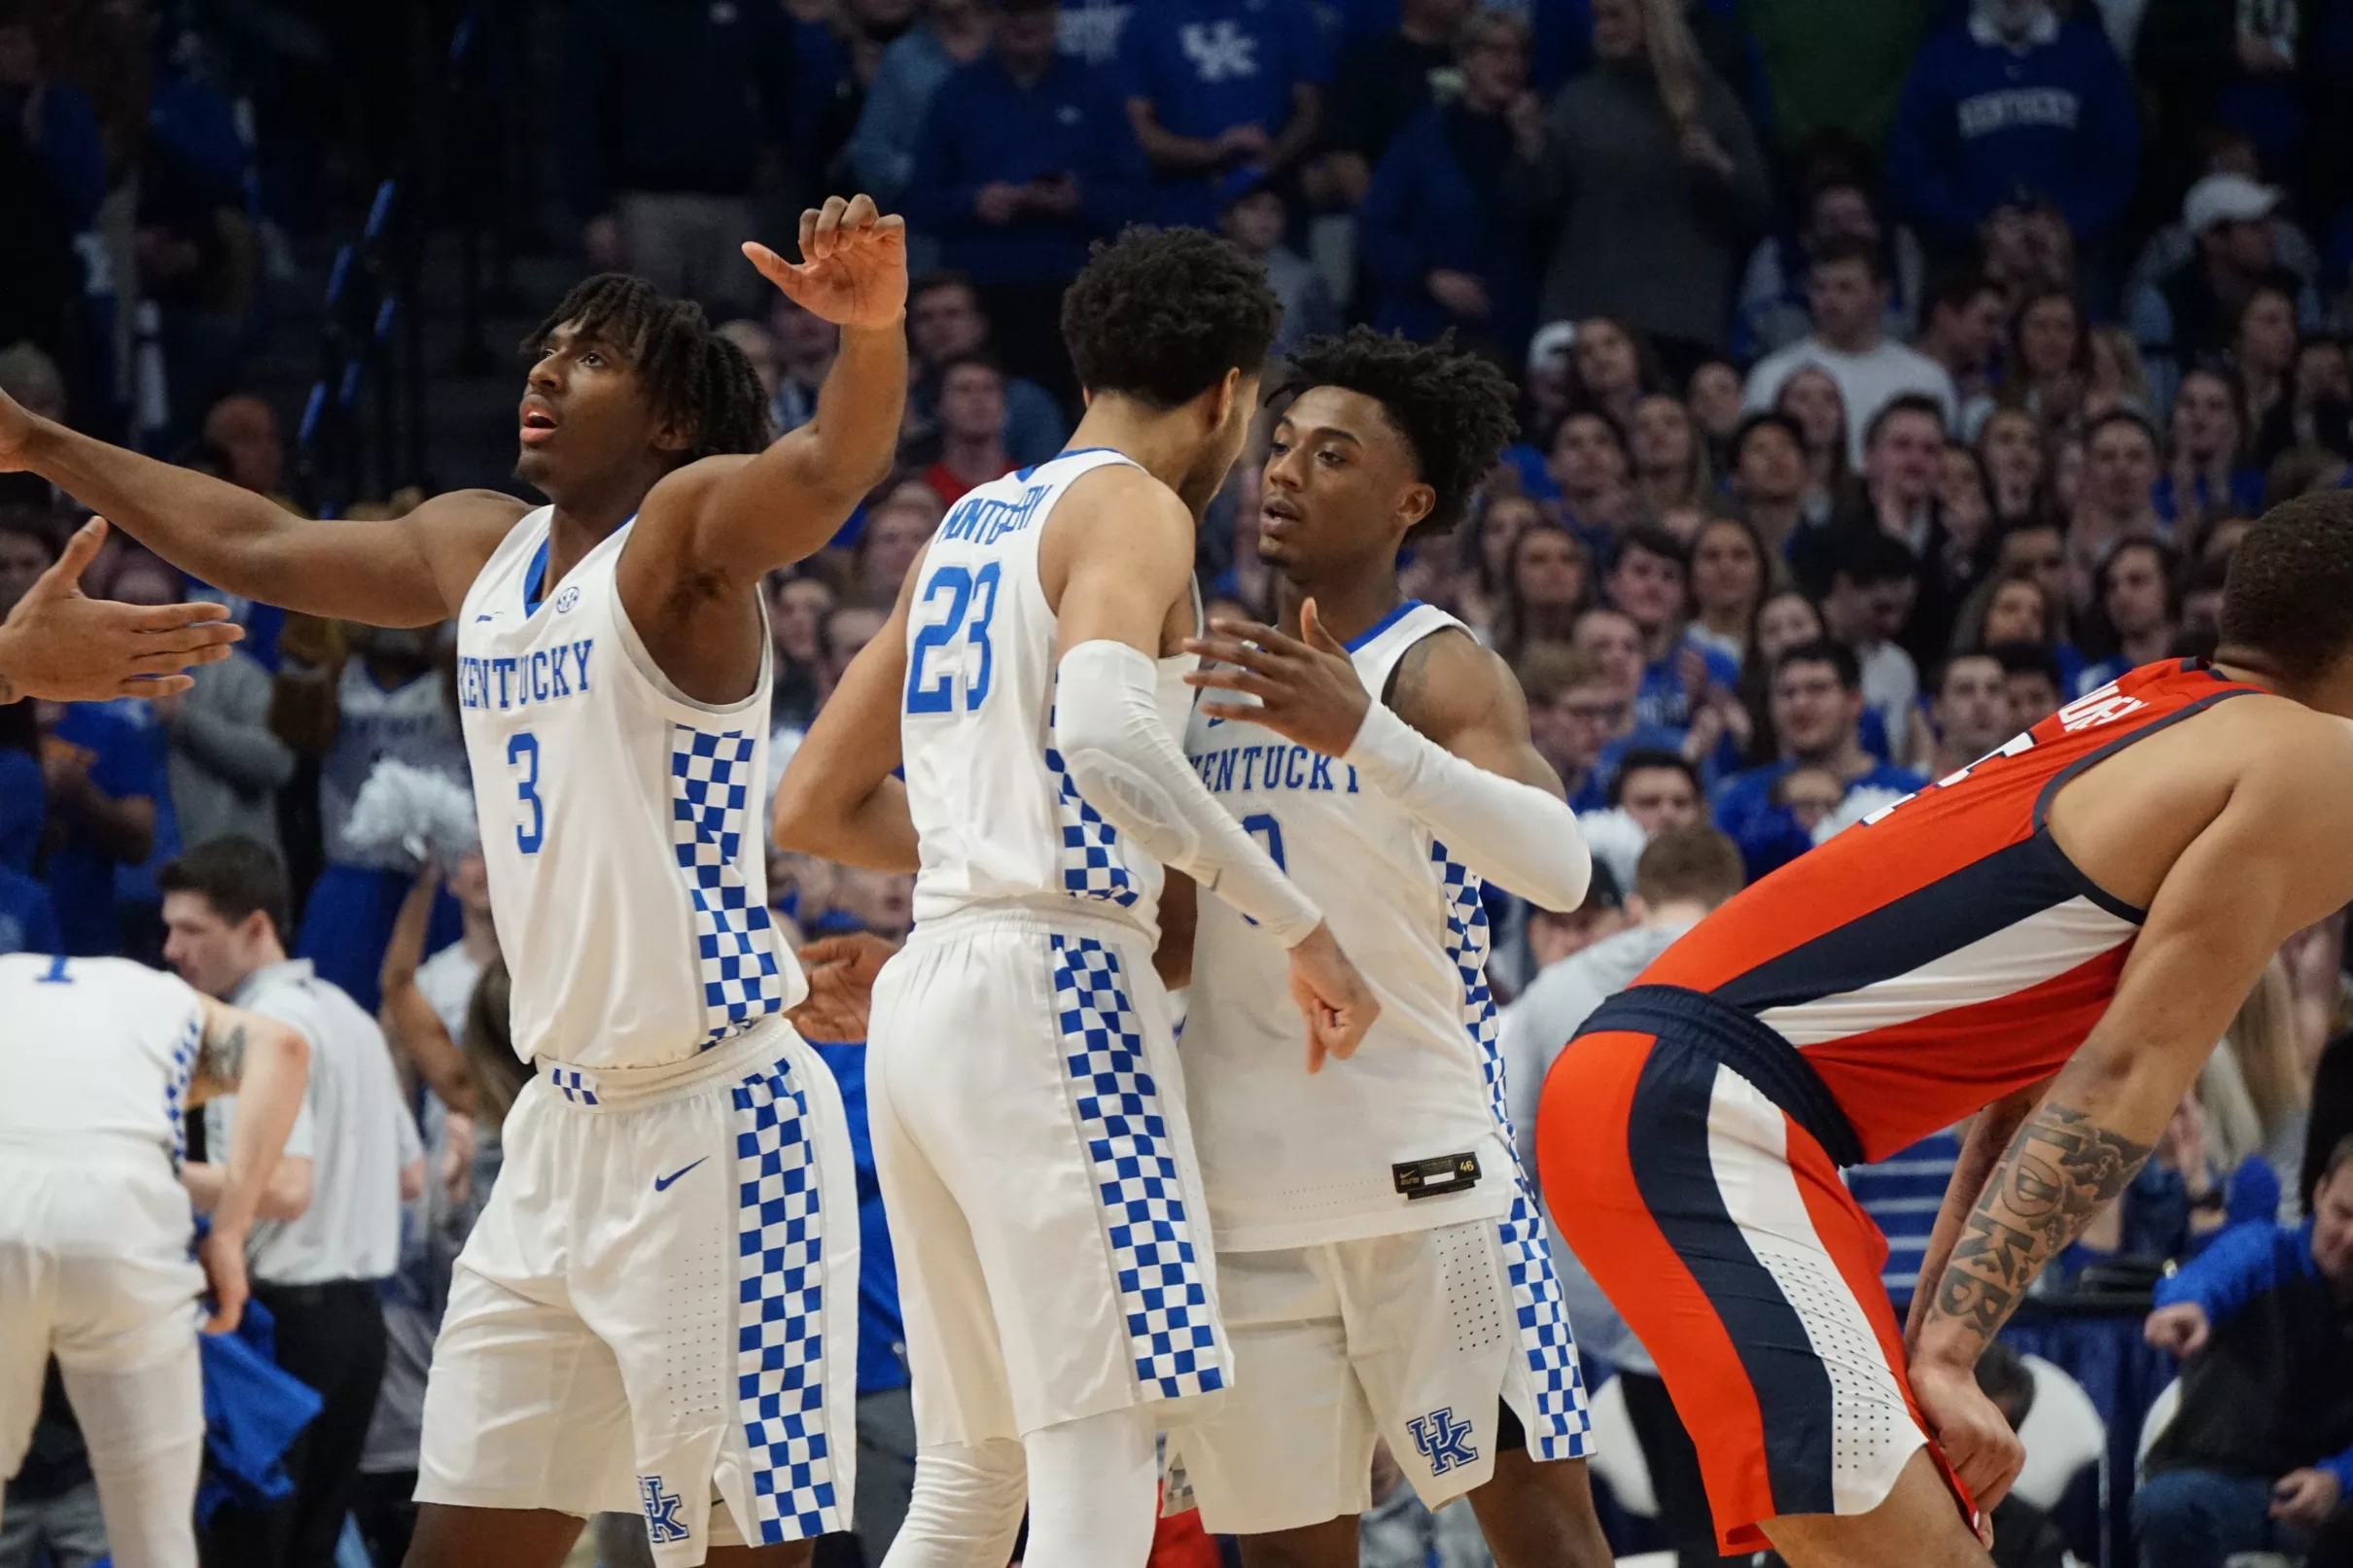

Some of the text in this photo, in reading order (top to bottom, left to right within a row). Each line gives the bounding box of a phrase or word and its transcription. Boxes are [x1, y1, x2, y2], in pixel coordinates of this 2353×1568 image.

[907, 561, 1001, 714] 23
[460, 638, 593, 709] KENTUCKY
[508, 732, 544, 854] 3
[1188, 745, 1359, 792] ENTUCKY
[1459, 1160, 1475, 1172] 46
[1406, 1407, 1479, 1477] UK
